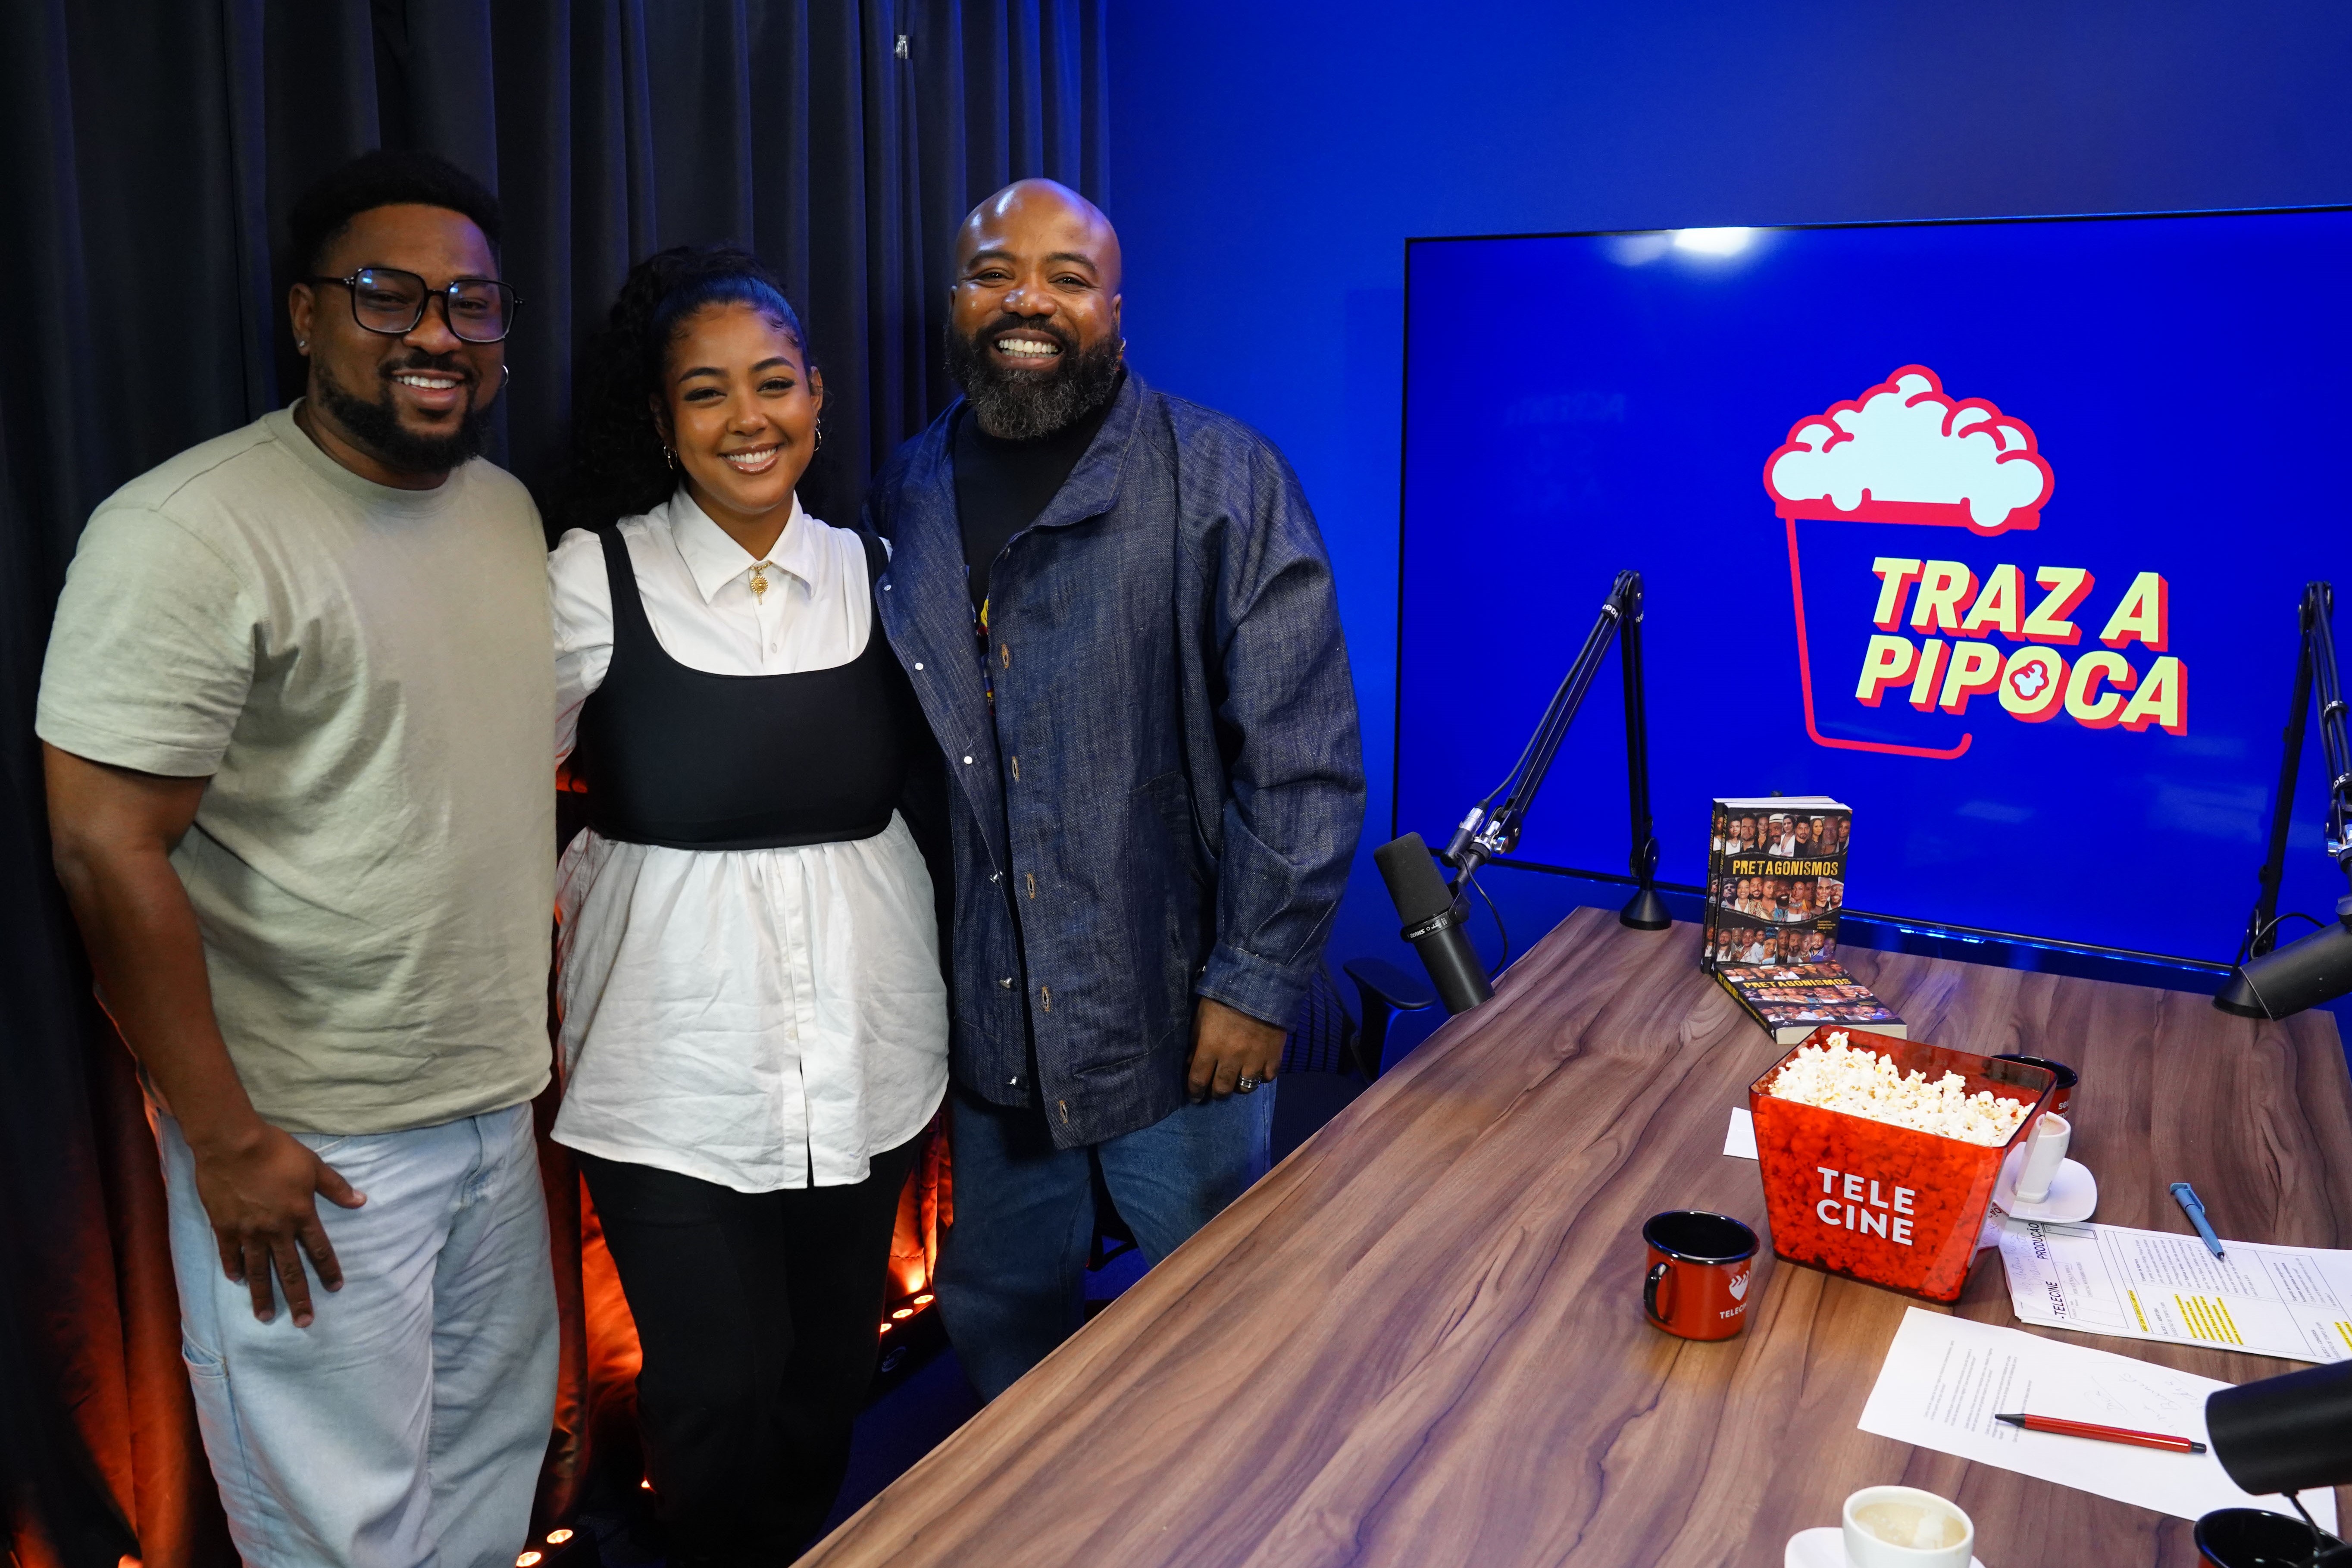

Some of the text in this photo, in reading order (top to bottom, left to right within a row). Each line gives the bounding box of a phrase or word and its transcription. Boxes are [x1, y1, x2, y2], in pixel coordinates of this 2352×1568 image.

[1873, 557, 2167, 651] TRAZ A
[1856, 635, 2187, 735] PIPOCA
[1733, 860, 1839, 876] PRETAGONISMOS
[1410, 929, 1425, 938] SHURE
[1717, 972, 1738, 999] PRETAGONISMOS
[1743, 978, 1852, 989] PRETAGONISMOS
[1817, 1167, 1915, 1215] TELE
[1817, 1200, 1913, 1246] CINE
[2028, 1223, 2049, 1260] PRODUÇÃO
